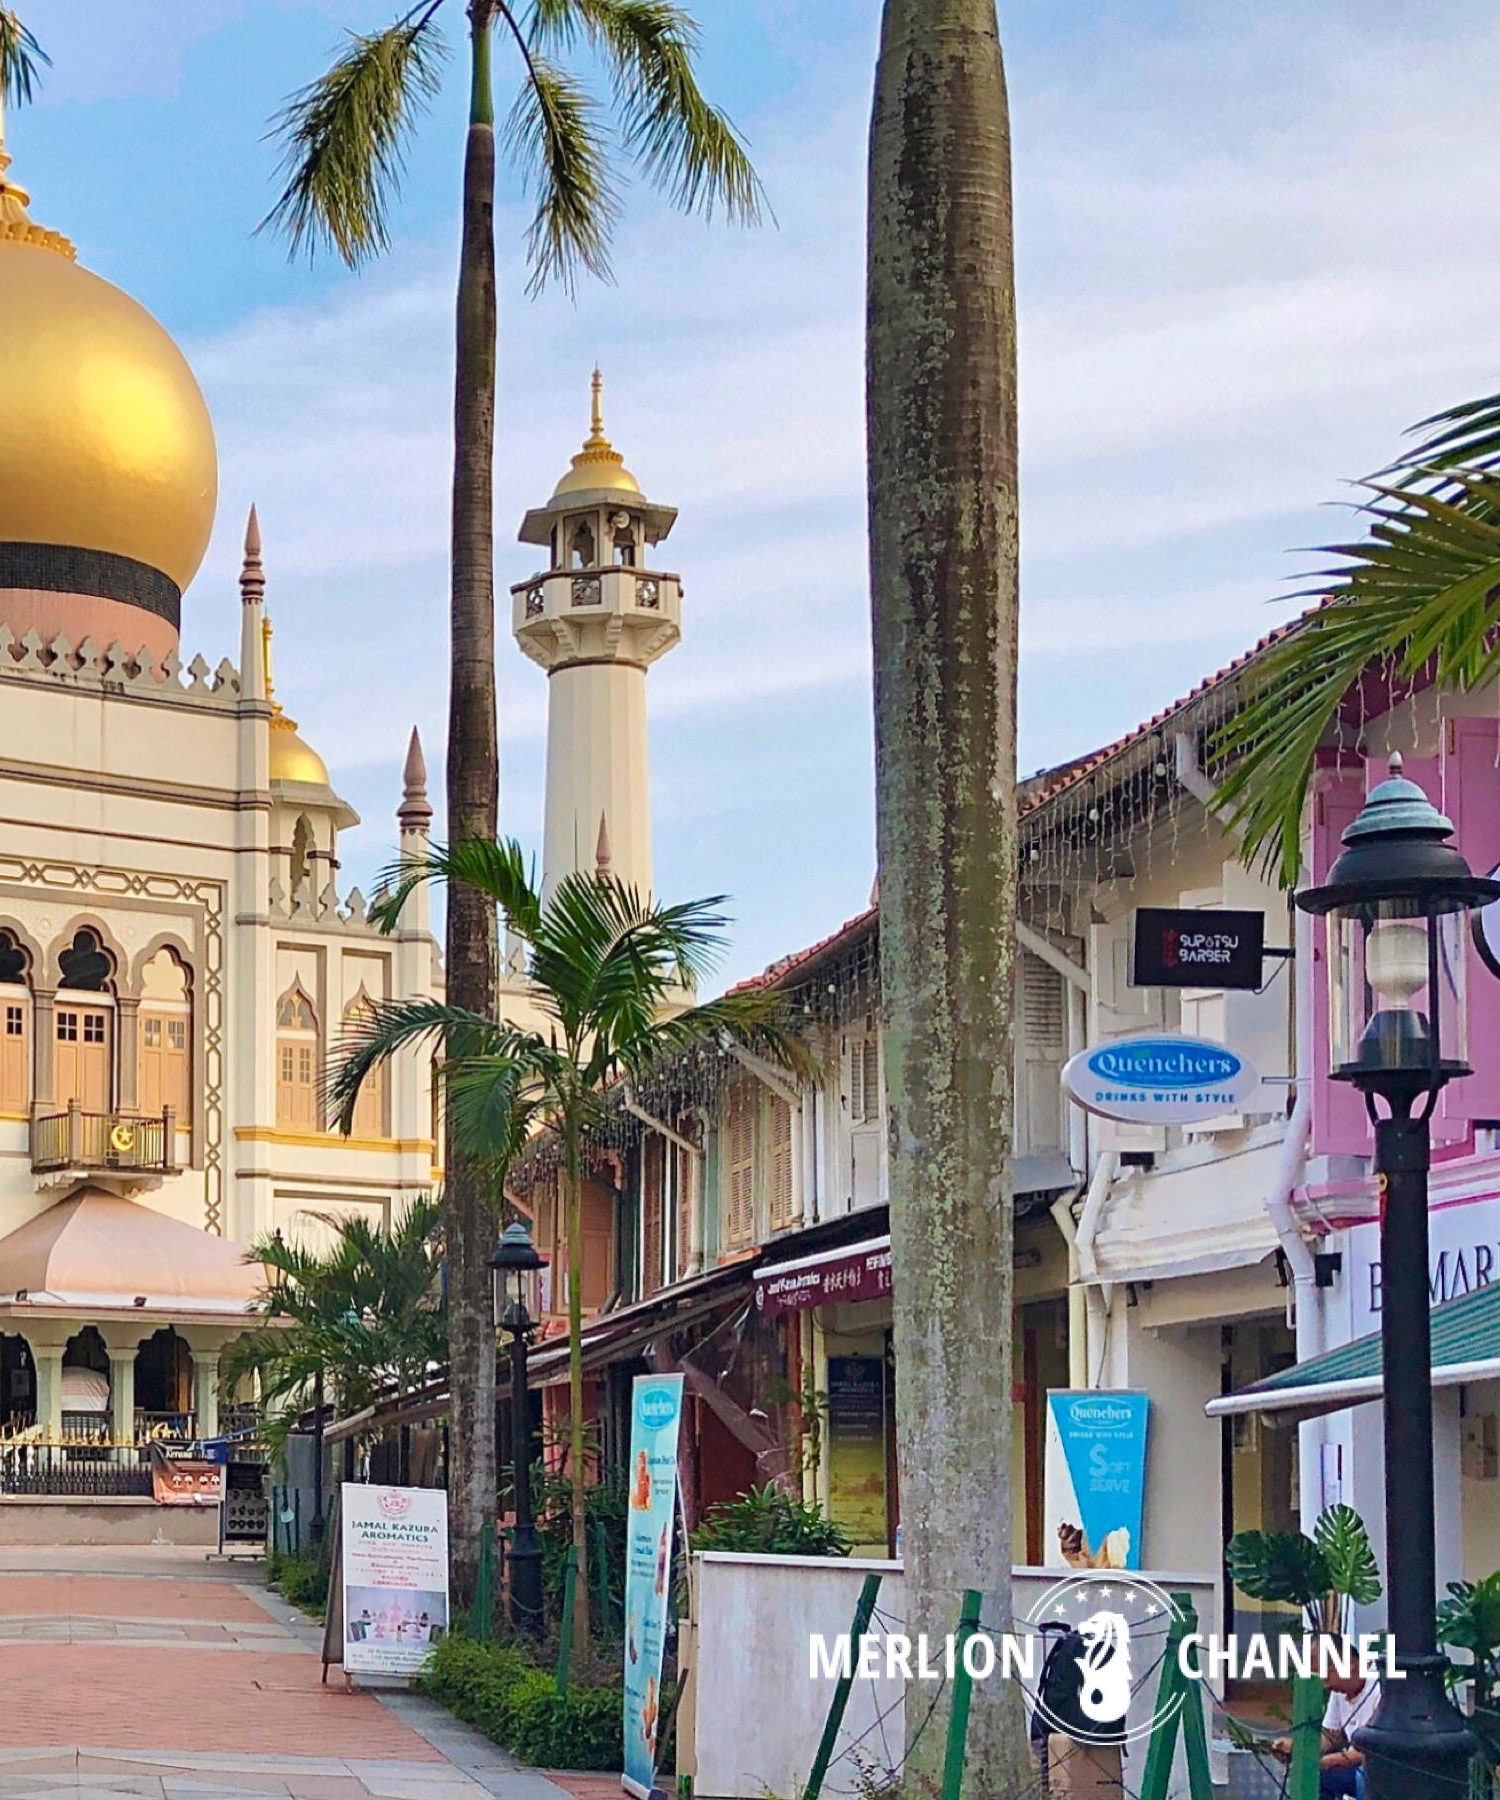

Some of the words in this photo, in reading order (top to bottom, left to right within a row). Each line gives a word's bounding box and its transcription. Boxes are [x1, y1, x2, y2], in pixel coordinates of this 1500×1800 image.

[1179, 949, 1231, 963] BARBER
[1098, 1053, 1232, 1077] Quenchers
[1095, 1092, 1147, 1102] DRINKS
[1153, 1093, 1188, 1102] WITH
[1196, 1094, 1235, 1103] STYLE
[1070, 1404, 1132, 1421] Quenchers
[351, 1520, 388, 1530] JAMAL
[391, 1523, 439, 1534] KAZURA
[361, 1531, 429, 1543] AROMATICS
